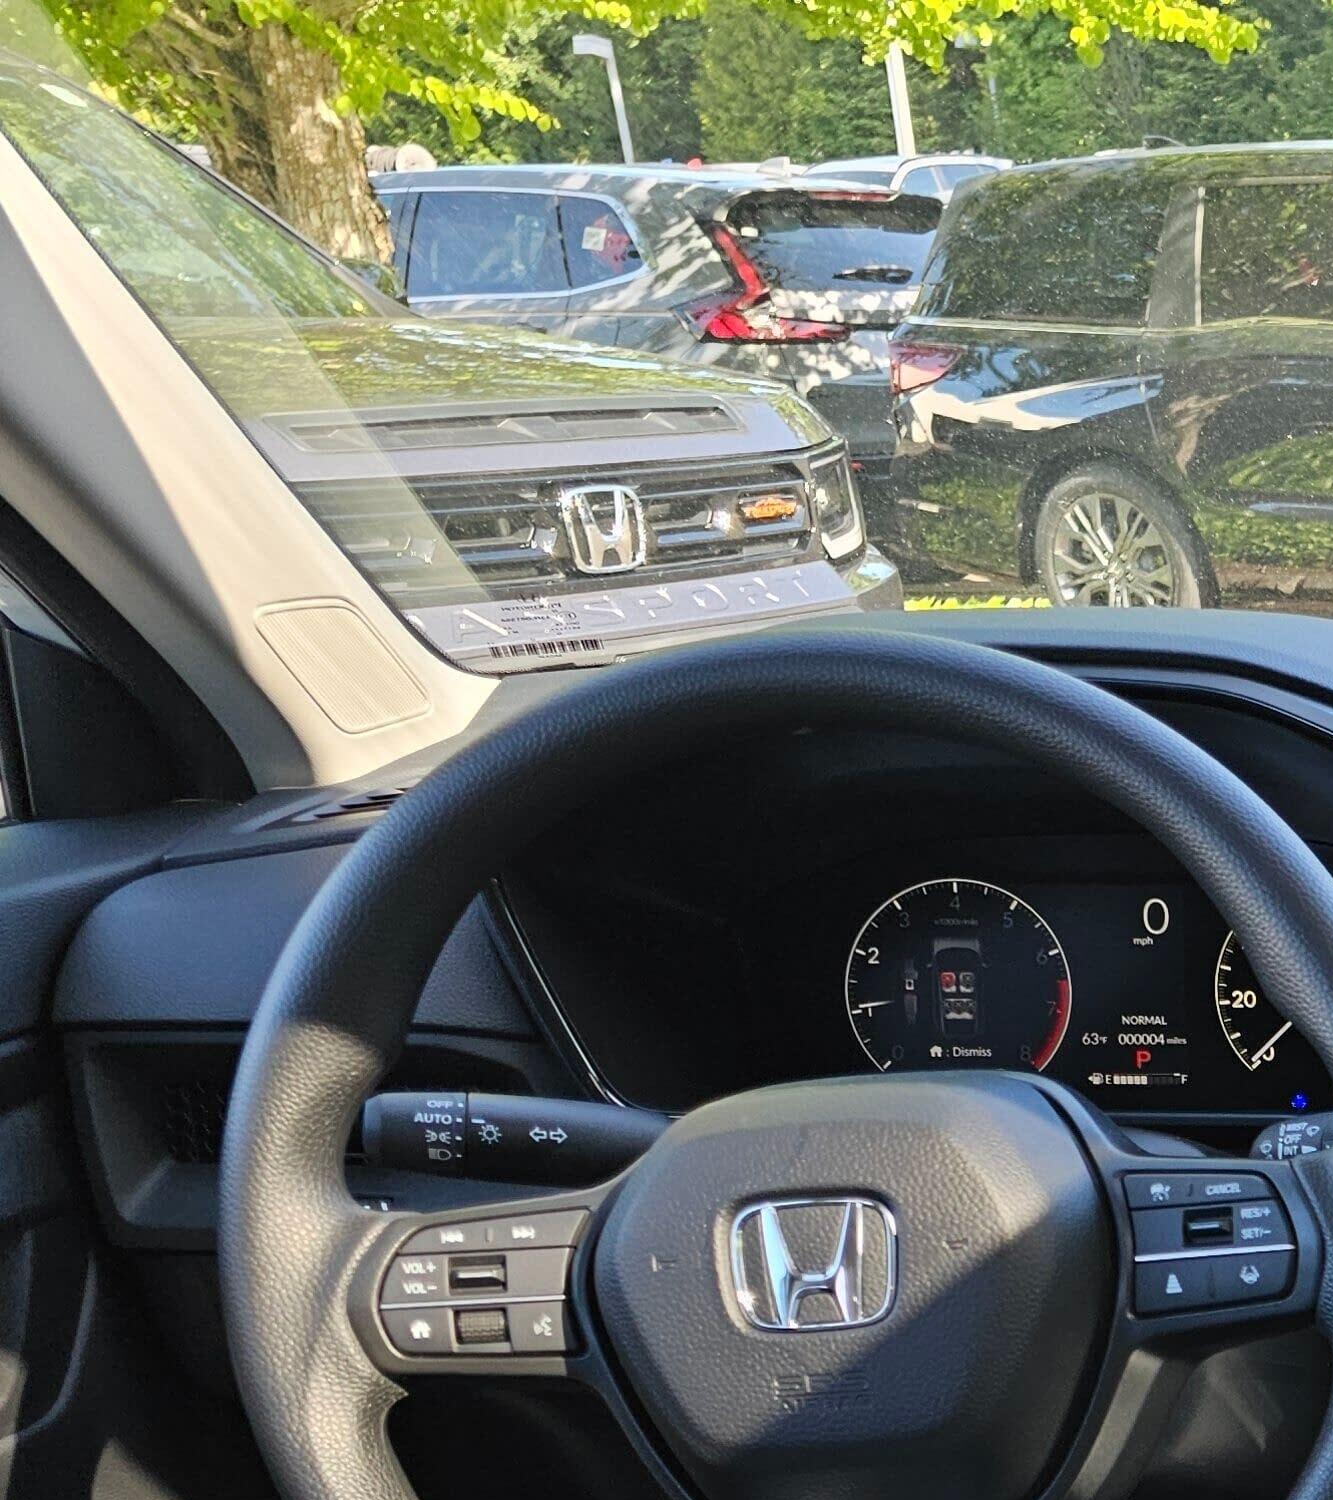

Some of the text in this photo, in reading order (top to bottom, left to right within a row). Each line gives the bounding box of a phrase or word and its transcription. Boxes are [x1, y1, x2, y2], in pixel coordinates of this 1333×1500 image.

[949, 895, 960, 911] 4
[899, 911, 911, 928] 3
[1003, 912, 1014, 929] 5
[1143, 897, 1170, 935] 0
[1133, 936, 1153, 946] mph
[867, 946, 881, 965] 2
[1036, 949, 1048, 966] 6
[1231, 990, 1257, 1009] 20
[1121, 1015, 1167, 1026] NORMAL
[1118, 1033, 1187, 1046] 000004 miles
[952, 1047, 993, 1058] Dismiss
[1136, 1050, 1152, 1069] P
[1105, 1073, 1112, 1085] E
[1180, 1073, 1188, 1085] F
[427, 1100, 453, 1109] OFF
[414, 1112, 452, 1125] AUTO
[1283, 1133, 1303, 1144] OFF
[1206, 1182, 1241, 1195] CANCEL
